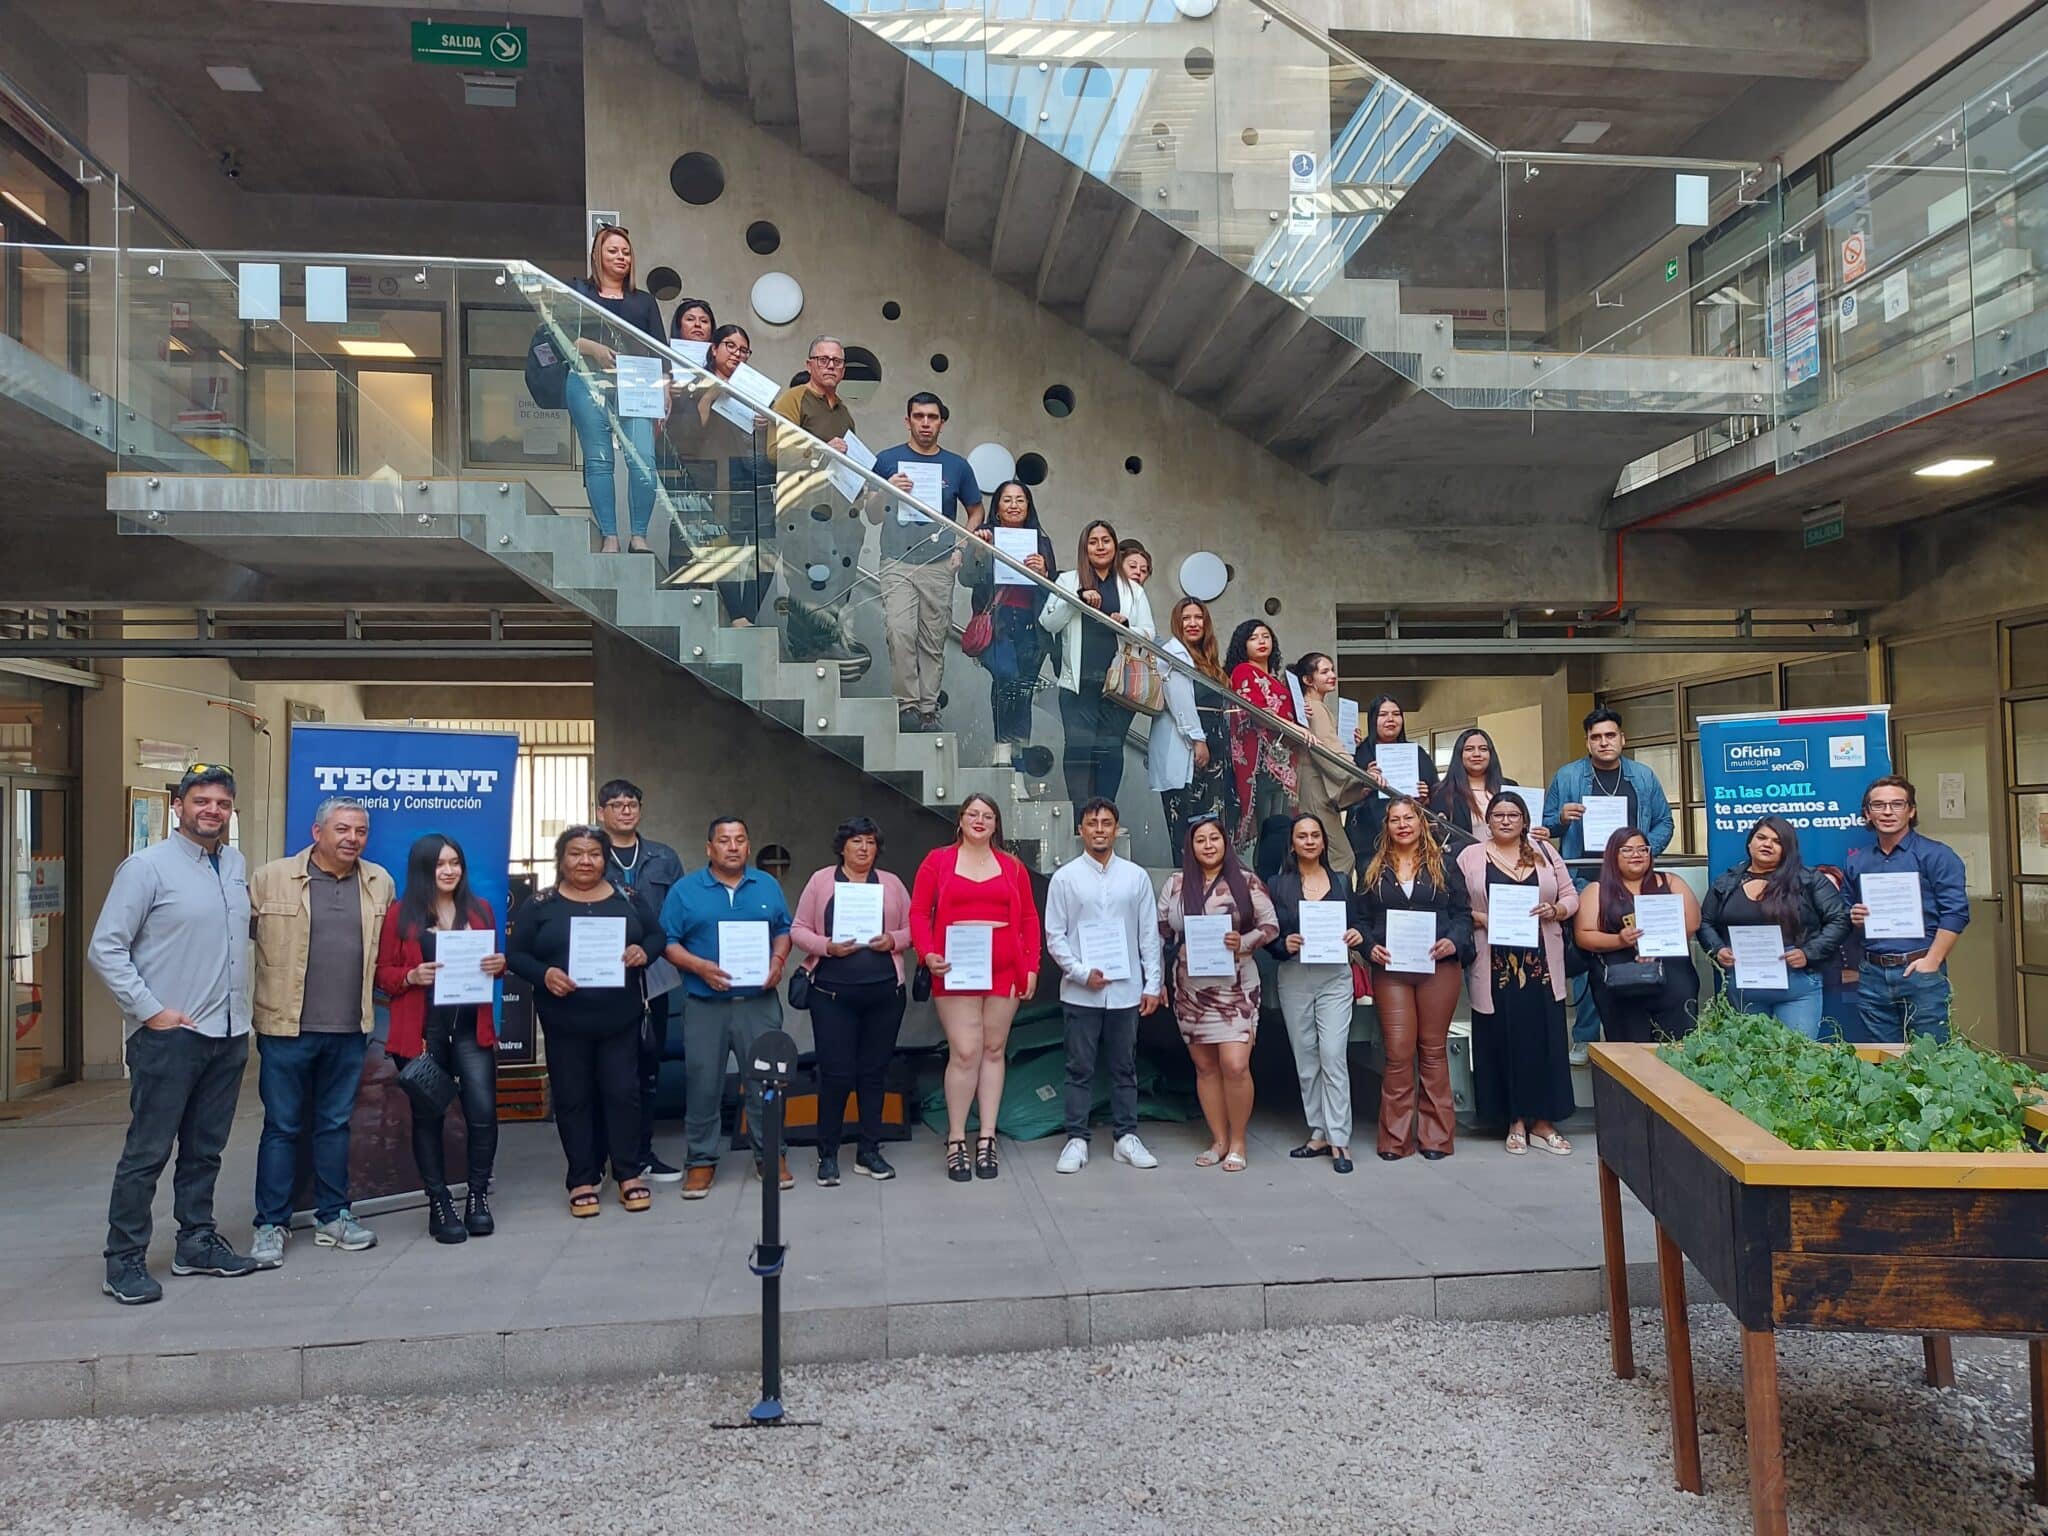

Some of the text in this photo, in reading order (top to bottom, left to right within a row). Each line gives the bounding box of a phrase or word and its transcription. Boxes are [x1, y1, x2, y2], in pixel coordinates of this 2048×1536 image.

[441, 34, 482, 49] SALIDA
[1730, 744, 1781, 759] Oficina
[1730, 758, 1769, 768] municipal
[314, 767, 498, 792] TECHINT
[1714, 783, 1816, 799] En las OMIL
[392, 797, 400, 812] y
[404, 795, 482, 809] Construcción
[1714, 801, 1839, 815] te acercamos a
[1716, 818, 1734, 830] tu
[1812, 814, 1867, 830] emple
